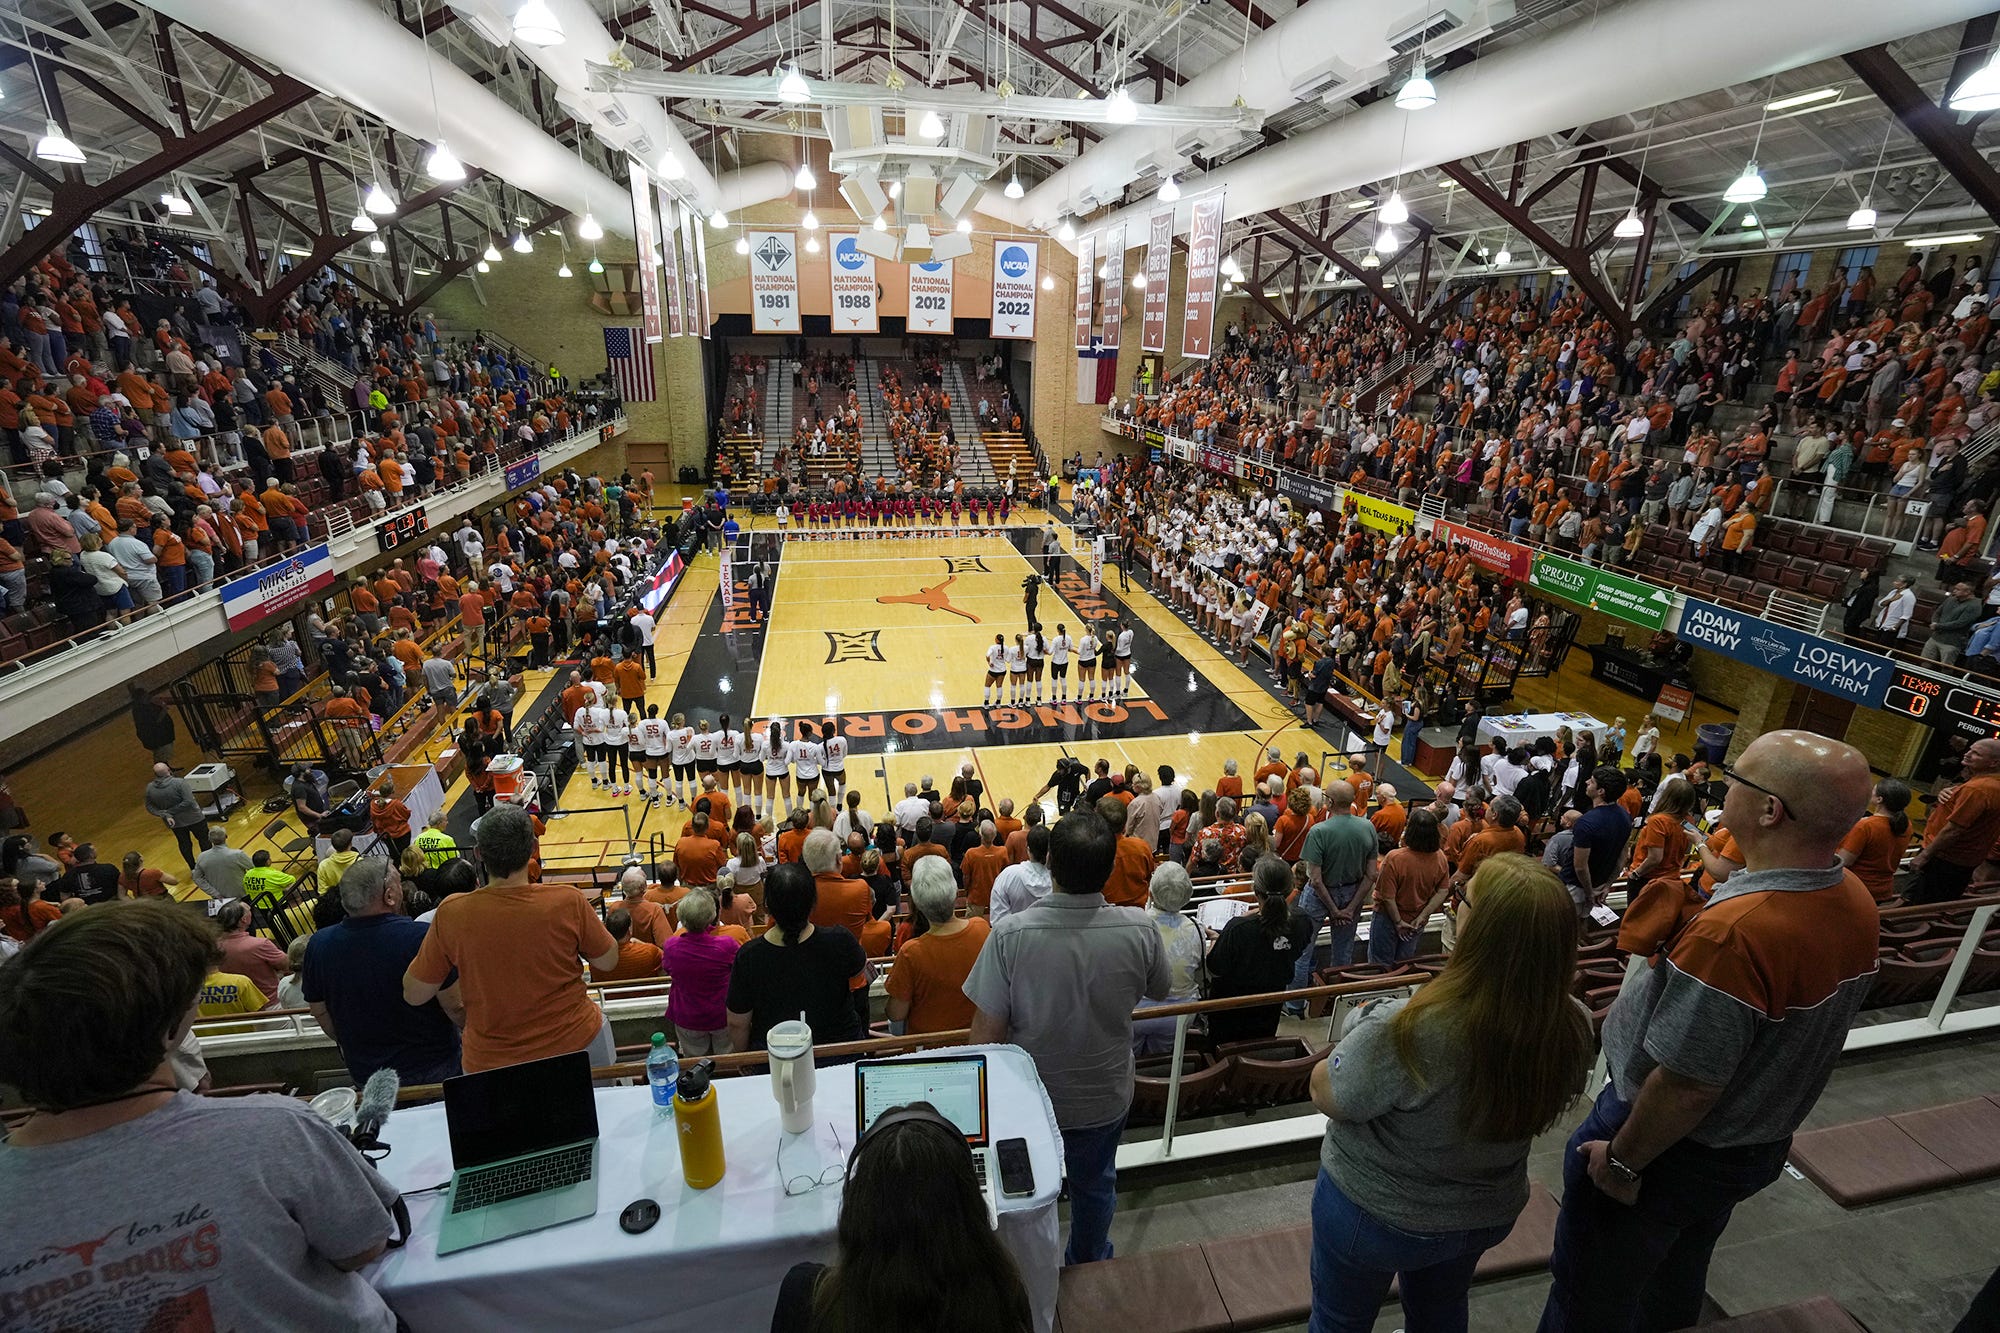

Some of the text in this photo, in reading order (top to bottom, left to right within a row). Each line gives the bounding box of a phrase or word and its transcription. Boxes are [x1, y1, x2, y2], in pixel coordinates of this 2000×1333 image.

[839, 253, 867, 262] NCAA
[1193, 246, 1215, 267] BIG 12
[1002, 261, 1030, 270] NCAA
[754, 275, 795, 283] NATIONAL
[912, 276, 950, 286] NATIONAL
[911, 284, 950, 294] CHAMPION
[996, 282, 1033, 291] NATIONAL
[995, 290, 1033, 299] CHAMPION
[759, 295, 790, 308] 1981
[838, 295, 871, 308] 1988
[915, 296, 946, 310] 2012
[998, 301, 1030, 315] 2022
[1360, 506, 1372, 516] REAL
[1373, 510, 1388, 521] TEXAS
[1540, 563, 1586, 587] SPROUTS
[722, 565, 731, 604] TEXAS
[1540, 574, 1580, 593] FARMERS MARKET
[1597, 584, 1614, 594] PROUD
[1614, 589, 1637, 601] SPONSOR
[1595, 591, 1660, 618] TEXAS WOMEN'S ATHLETICS
[1691, 609, 1741, 634] ADAM
[1685, 621, 1742, 650] LOEWY
[1751, 636, 1767, 646] LOEWY
[1797, 643, 1881, 682] LOEWY
[1794, 661, 1869, 696] LAW FIRM
[1900, 674, 1941, 696] TEXAS
[1909, 695, 1926, 715] 0
[582, 714, 592, 724] 18
[646, 724, 659, 734] 55
[1958, 721, 1985, 735] PERIOD
[679, 736, 687, 745] 9
[700, 740, 712, 750] 22
[720, 736, 734, 747] 44
[800, 749, 807, 759] 11
[828, 743, 841, 754] 14
[244, 876, 266, 885] EVENT
[127, 1221, 165, 1246] for
[169, 1203, 212, 1228] the
